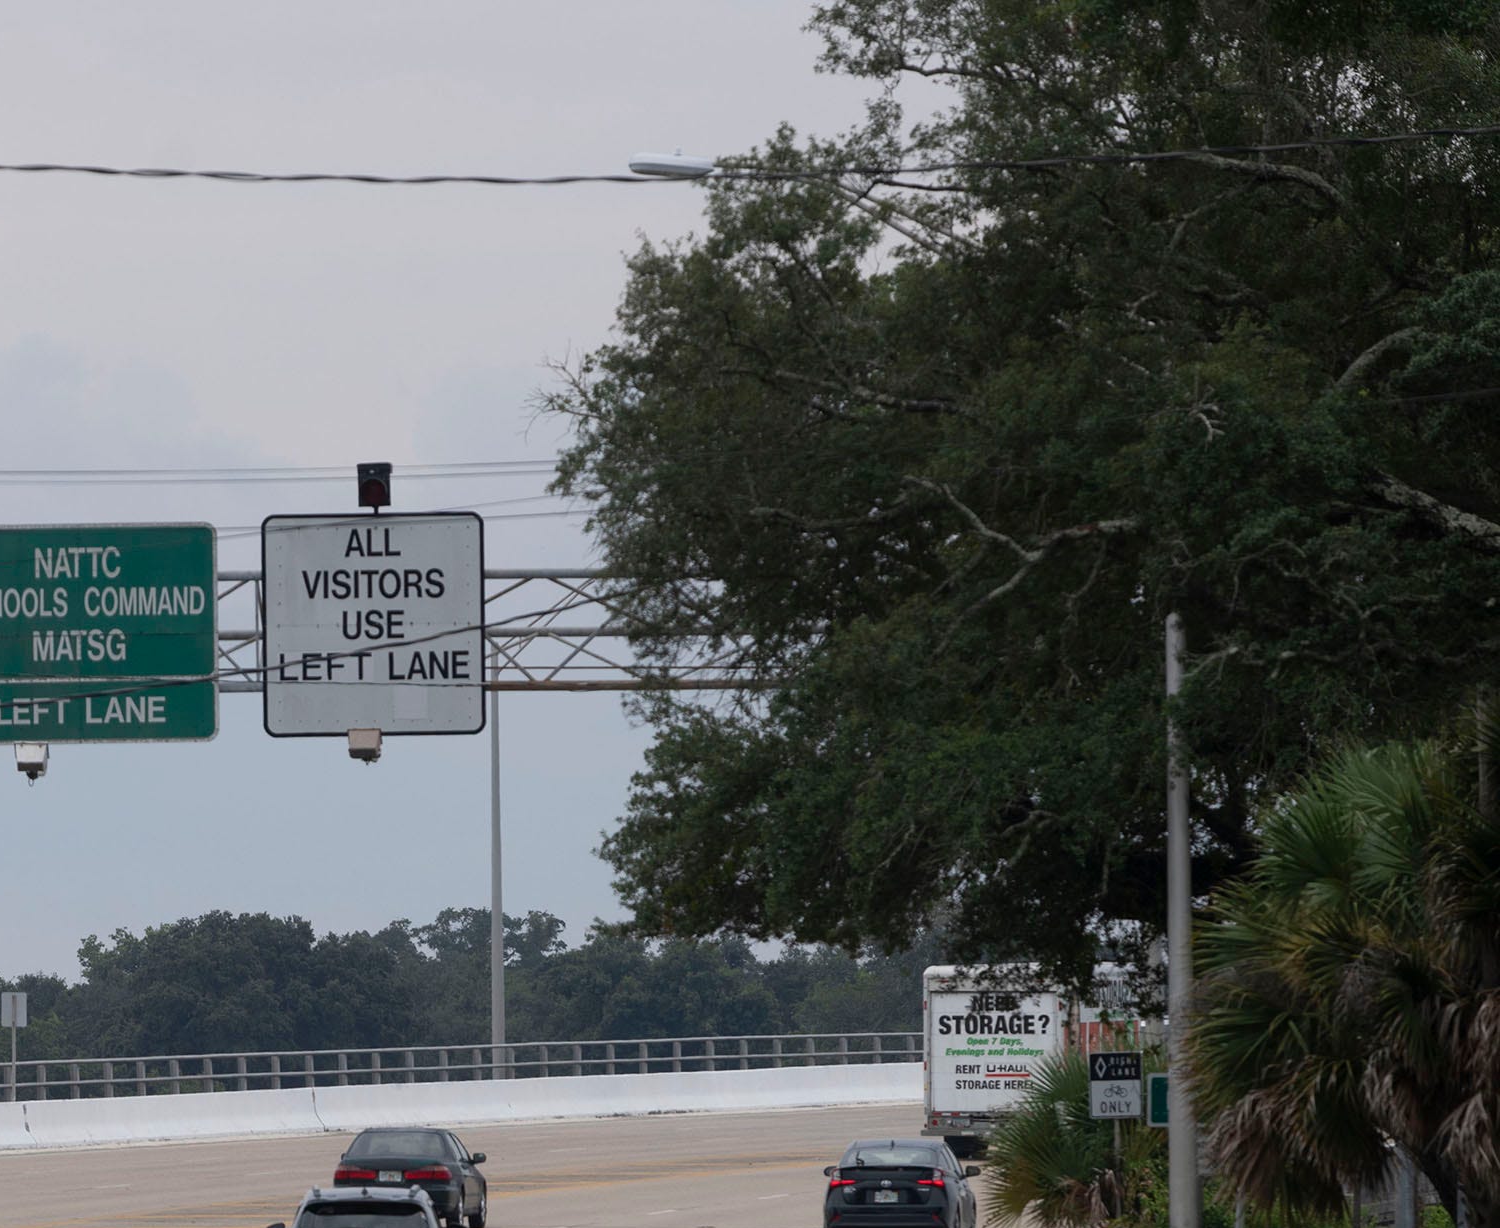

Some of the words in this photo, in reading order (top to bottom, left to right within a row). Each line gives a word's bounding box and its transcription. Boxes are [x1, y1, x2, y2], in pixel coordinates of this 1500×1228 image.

[345, 528, 401, 558] ALL
[34, 546, 121, 578] NATTC
[302, 568, 445, 599] VISITORS
[84, 585, 205, 617] COMMAND
[342, 610, 405, 640] USE
[32, 629, 127, 661] MATSG
[280, 652, 372, 681] LEFT
[389, 650, 470, 680] LANE
[86, 697, 166, 723] LANE
[938, 1014, 1050, 1035] STORAGE?
[945, 1048, 985, 1057] Evenings
[987, 1048, 1005, 1056] and
[1007, 1048, 1044, 1057] Holidays
[966, 1037, 988, 1046] Open
[991, 1037, 998, 1045] 7
[955, 1064, 981, 1074] RENT
[986, 1064, 1029, 1073] U-HAUL
[955, 1080, 1001, 1090] STORAGE
[1100, 1101, 1132, 1113] ONLY
